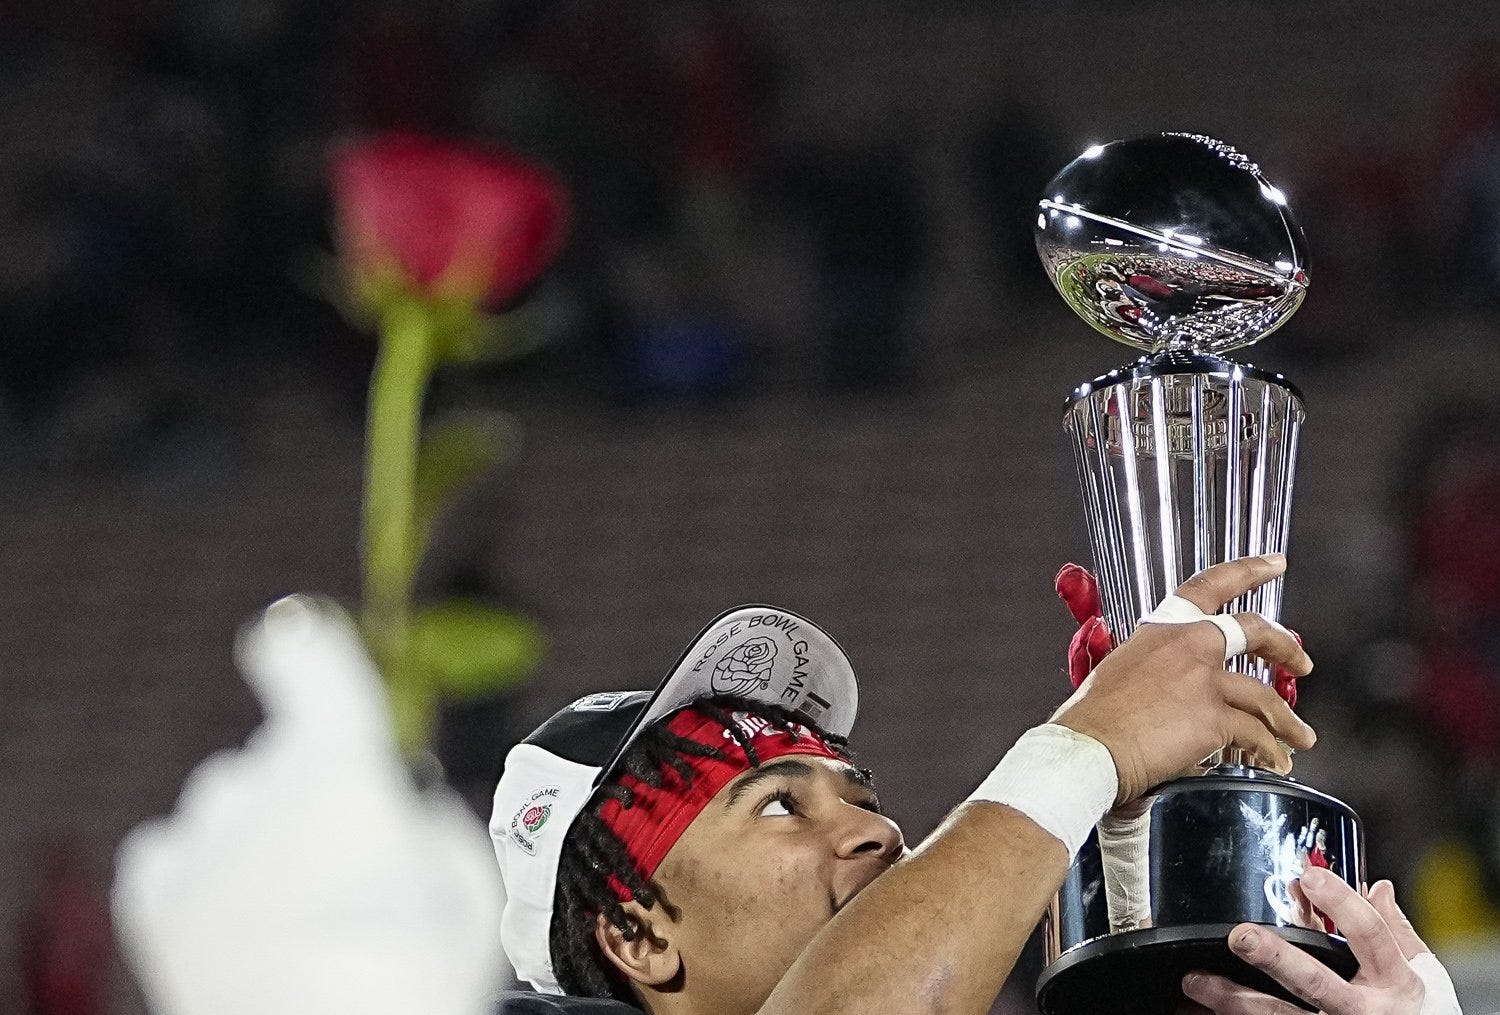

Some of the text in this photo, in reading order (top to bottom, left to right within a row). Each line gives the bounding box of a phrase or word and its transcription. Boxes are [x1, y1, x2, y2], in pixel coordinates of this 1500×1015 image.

[693, 614, 810, 703] ROSE BOWL GAME
[531, 788, 560, 801] GAME
